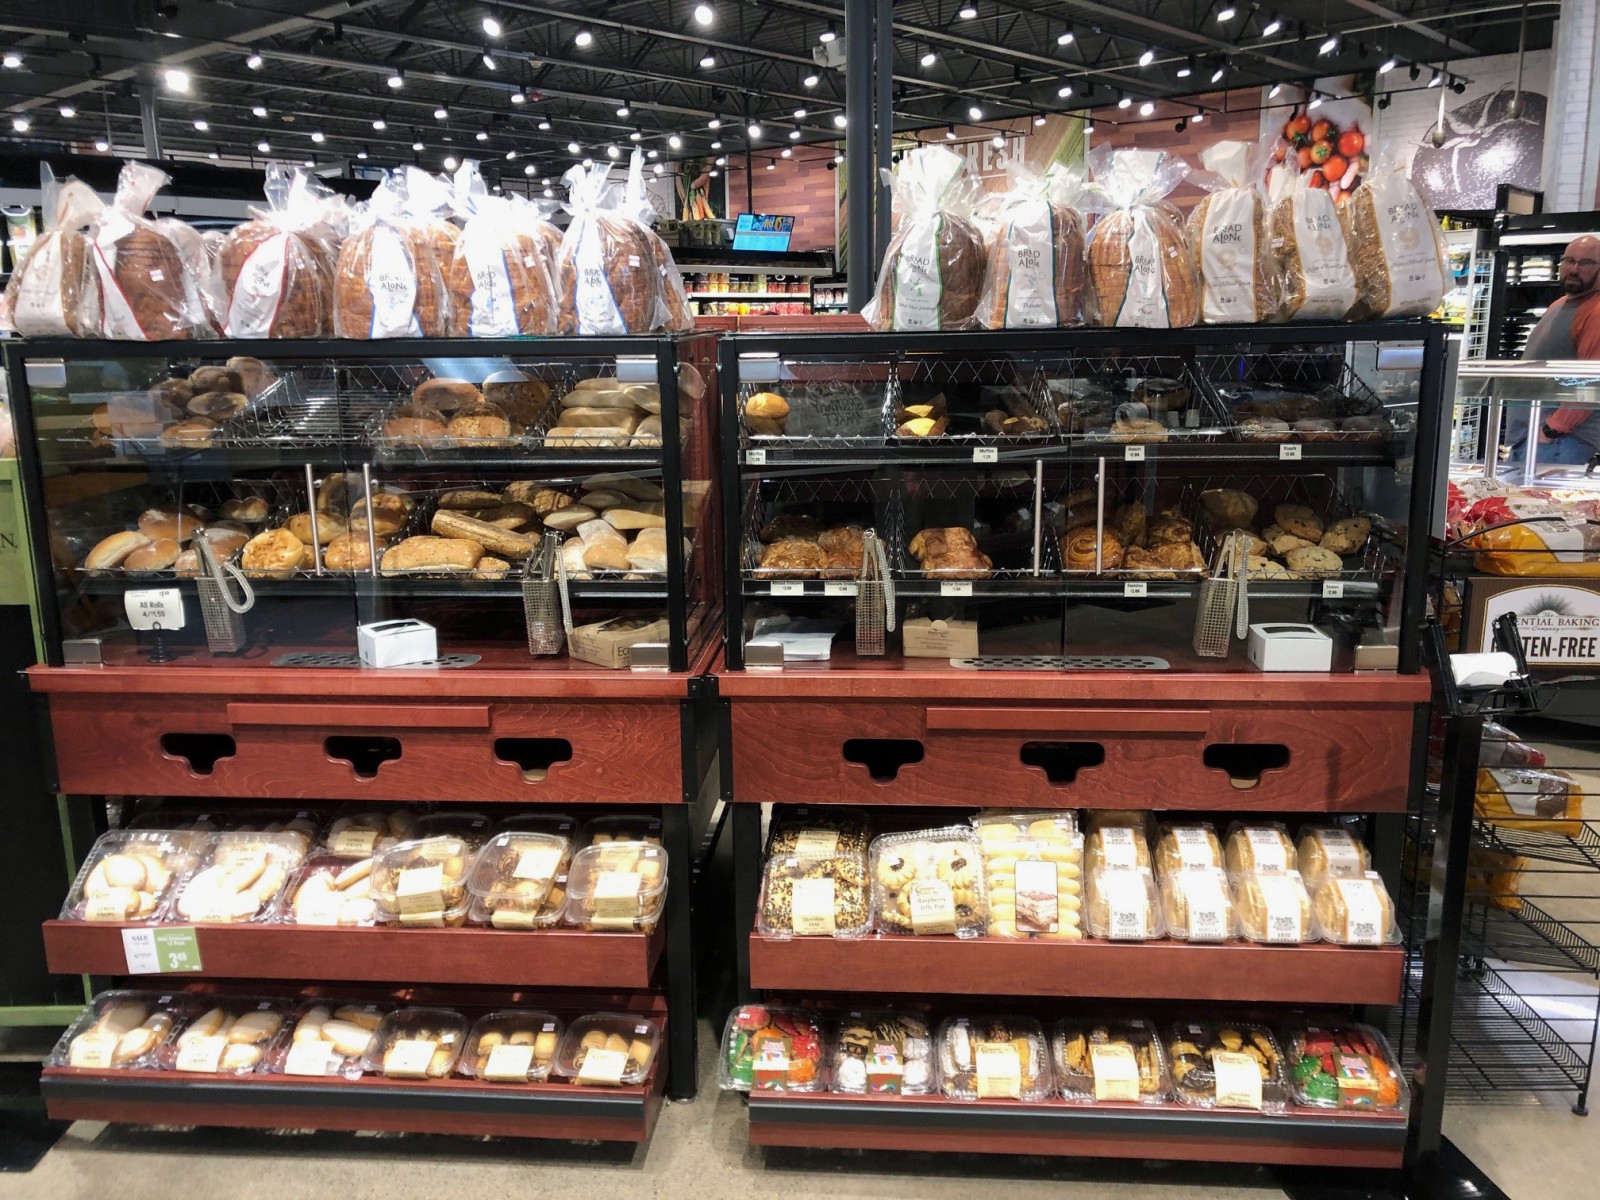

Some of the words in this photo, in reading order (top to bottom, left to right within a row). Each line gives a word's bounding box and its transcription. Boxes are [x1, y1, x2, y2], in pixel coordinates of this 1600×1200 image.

[953, 136, 1026, 176] FRESH
[1305, 214, 1330, 224] BAD
[1213, 223, 1242, 234] BEAD
[1212, 233, 1242, 244] ALONE
[1017, 248, 1041, 259] BREAD
[1018, 257, 1041, 268] ALONE
[379, 273, 406, 282] BRA
[380, 281, 408, 293] ALONE
[1515, 617, 1553, 627] ENTIAL
[1558, 617, 1600, 627] BAKING
[1531, 625, 1560, 633] Company
[1491, 636, 1598, 658] TEN-FREE
